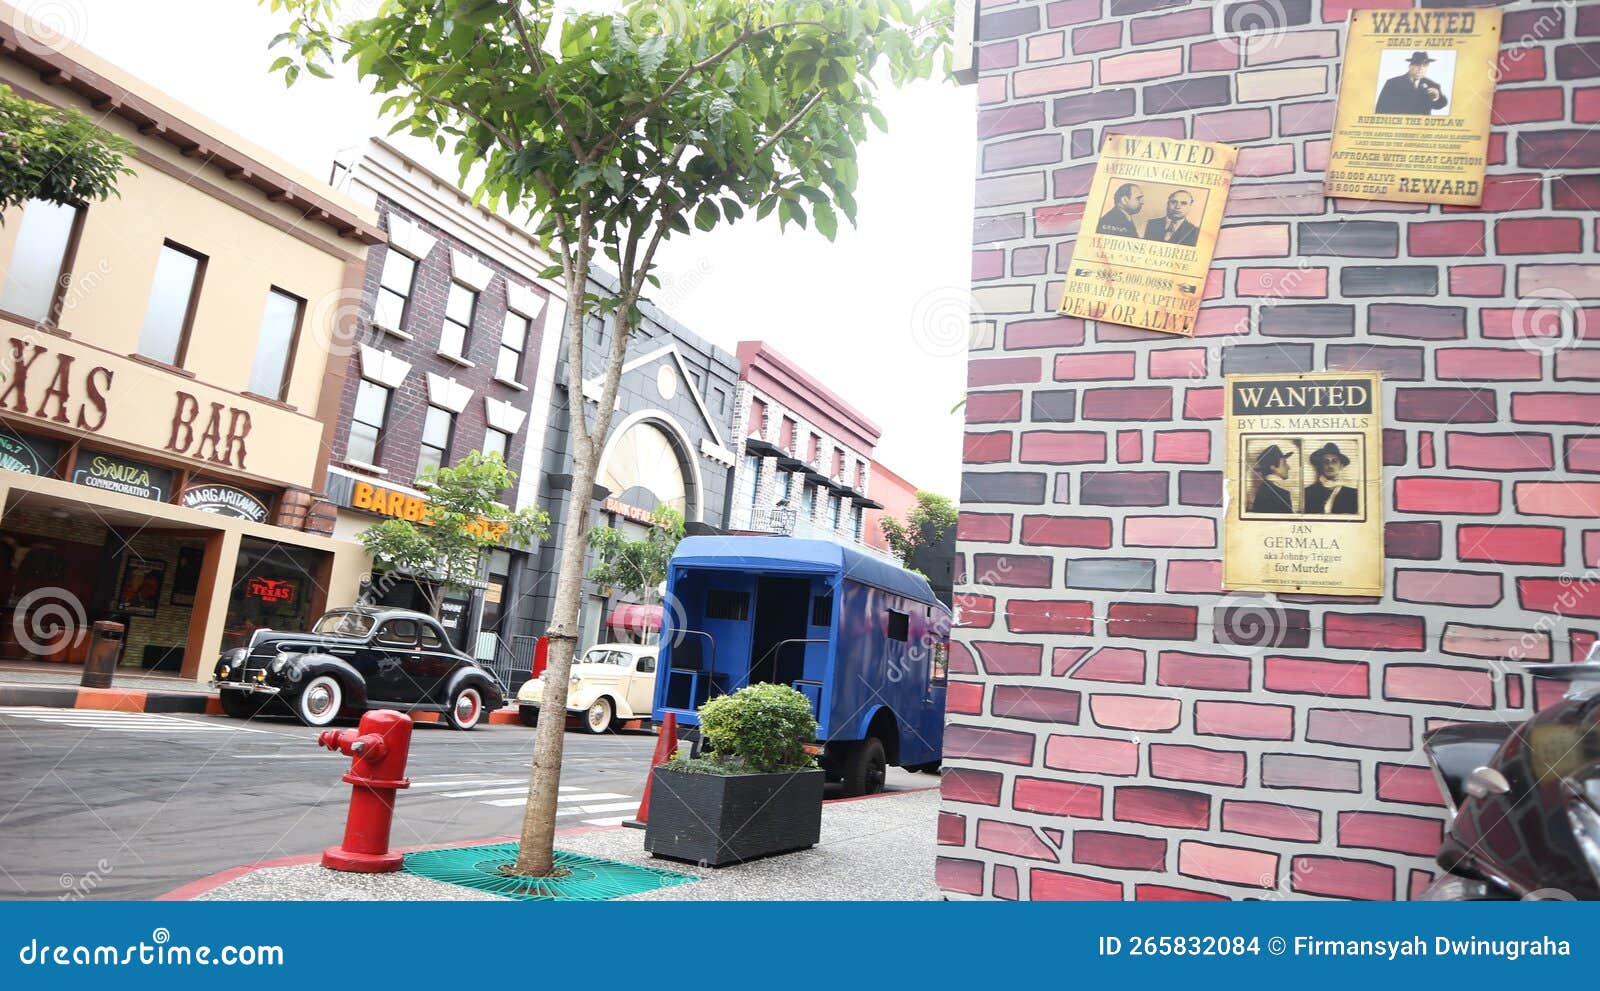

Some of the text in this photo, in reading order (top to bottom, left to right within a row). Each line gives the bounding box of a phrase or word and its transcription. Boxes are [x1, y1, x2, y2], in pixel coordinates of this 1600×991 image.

[1371, 12, 1476, 33] WANTED
[1387, 38, 1412, 47] DEAD
[1424, 38, 1454, 47] ALIVE
[1405, 117, 1421, 126] THE
[1424, 118, 1465, 127] OUTLAW
[1125, 138, 1215, 165] WANTED
[1332, 151, 1380, 161] APPROACH
[1382, 153, 1406, 162] WITH
[1408, 154, 1438, 164] GREAT
[1440, 156, 1483, 166] CAUTION
[1104, 162, 1222, 186] AMERICAN GANGSTER
[1367, 173, 1395, 182] ALIVE
[1362, 185, 1388, 194] DEAD
[1398, 178, 1479, 196] REWARD
[1089, 237, 1199, 263] ALPHONSE GABRIEL
[1144, 258, 1190, 271] CAPONE
[1069, 280, 1197, 312] REWARD FOR CAPTURE
[1062, 296, 1193, 333] DEAD OR ALIVE
[1238, 385, 1368, 408] WANTED
[164, 390, 253, 470] BAR
[1237, 417, 1369, 430] BY U.S. MARSHALS
[90, 456, 150, 487] SAUZA
[605, 498, 630, 517] BANK
[1291, 525, 1312, 534] JAN
[1263, 536, 1340, 550] GERMALA
[1264, 552, 1342, 563] aka Johnny Trigger
[1275, 563, 1329, 573] for Murder
[252, 583, 290, 599] TEXAS
